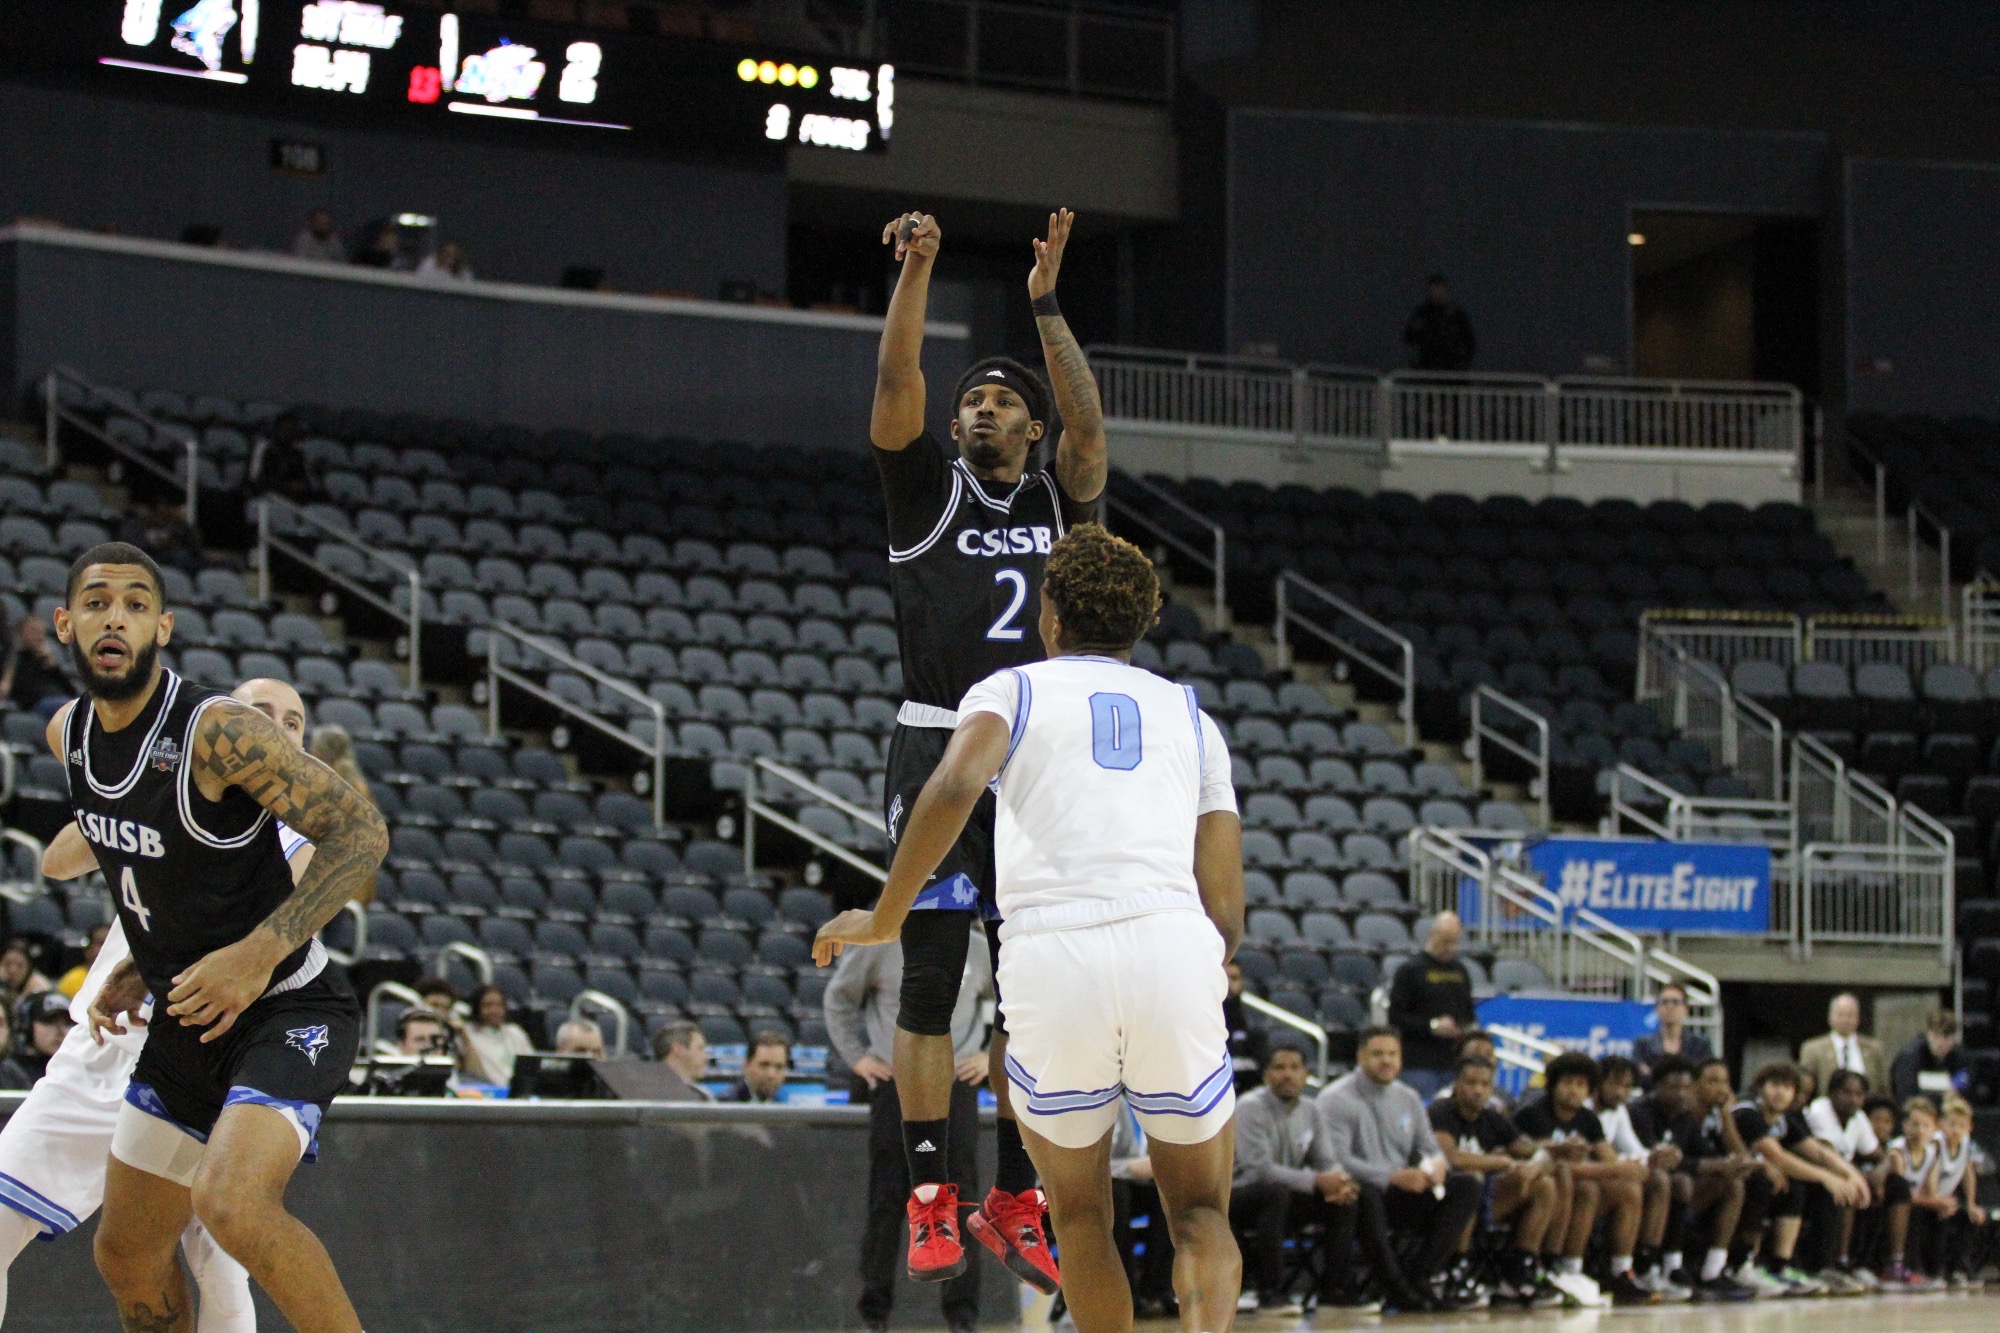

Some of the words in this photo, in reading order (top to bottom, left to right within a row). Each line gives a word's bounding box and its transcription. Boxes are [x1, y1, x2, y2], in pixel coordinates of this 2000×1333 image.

[559, 42, 602, 103] 2
[985, 567, 1028, 641] 2
[1088, 692, 1143, 771] 0
[121, 866, 151, 932] 4
